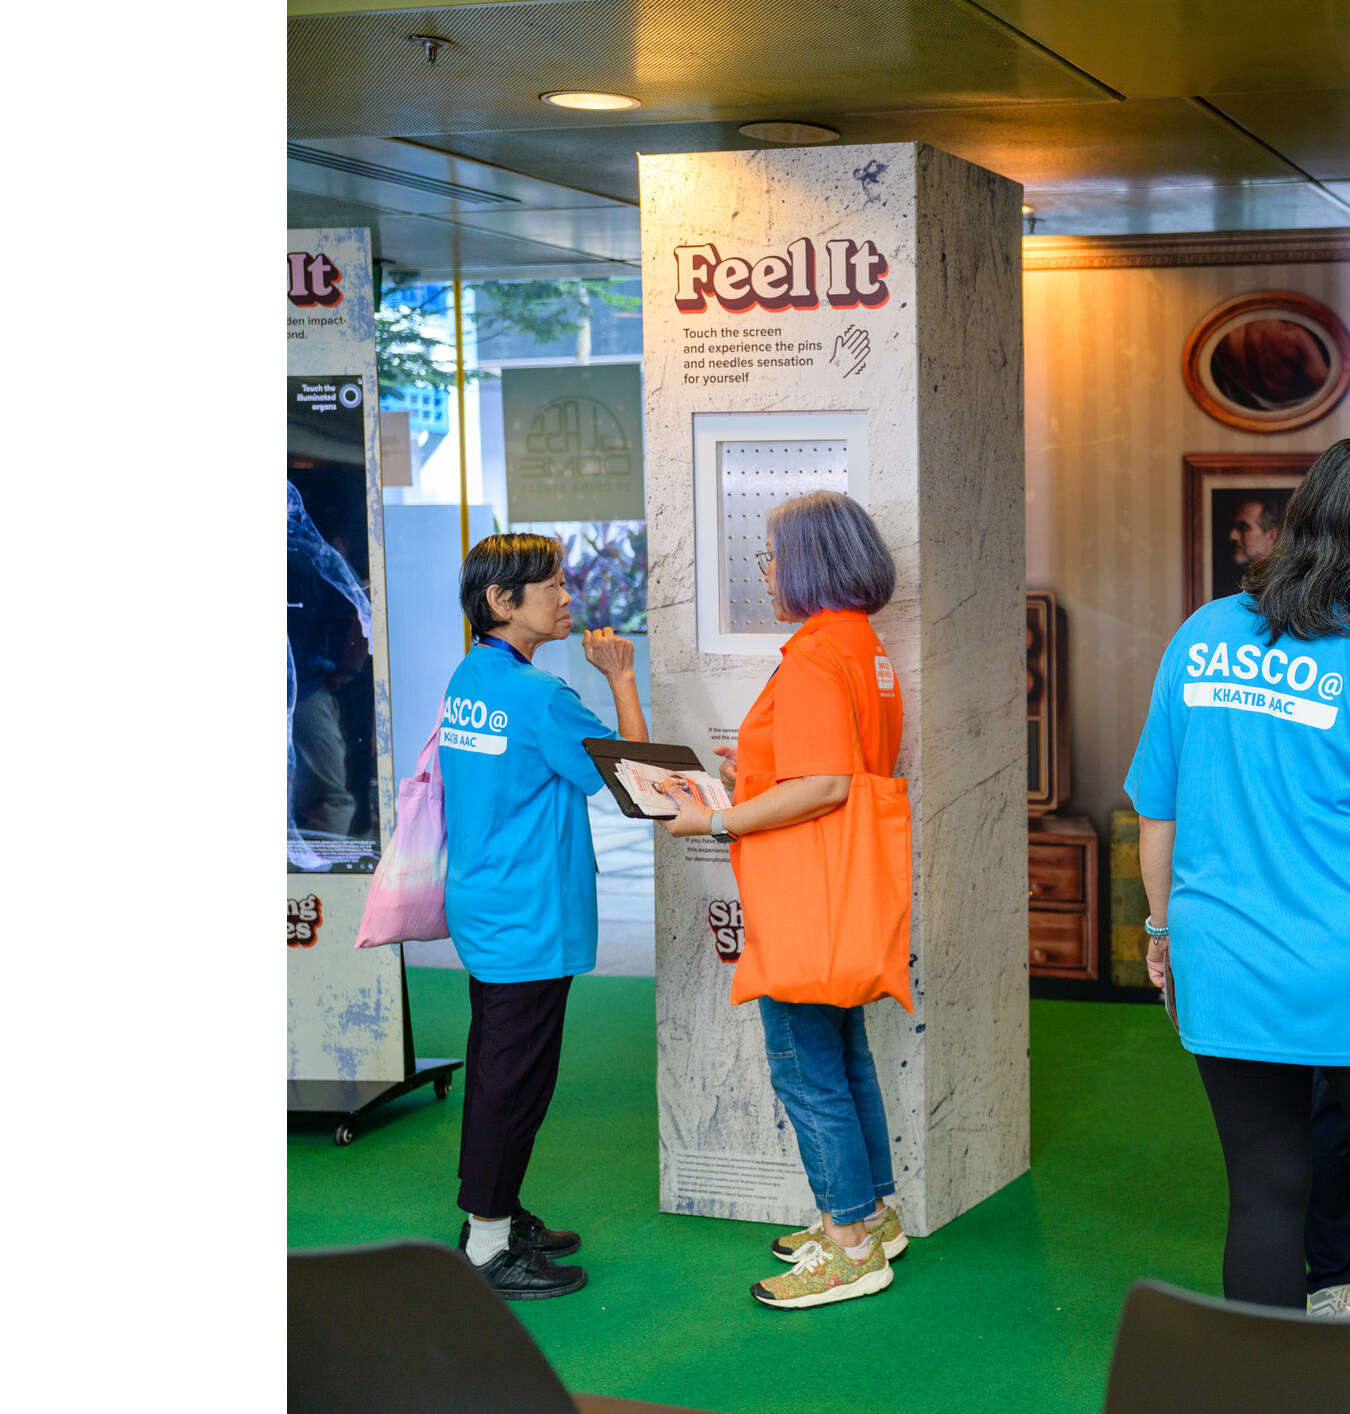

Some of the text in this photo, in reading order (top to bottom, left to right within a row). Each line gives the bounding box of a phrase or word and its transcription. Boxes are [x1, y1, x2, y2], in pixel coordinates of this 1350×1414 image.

[287, 252, 343, 307] It
[674, 237, 889, 313] Feel It
[308, 316, 347, 328] impact-
[683, 326, 782, 339] Touch the screen
[683, 340, 823, 356] and experience the pins
[683, 356, 814, 369] and needles sensation
[684, 372, 749, 387] for yourself
[301, 384, 336, 392] Touch the
[312, 403, 337, 412] organs
[1213, 688, 1295, 715] KHATIB AAC
[459, 735, 477, 748] AAC
